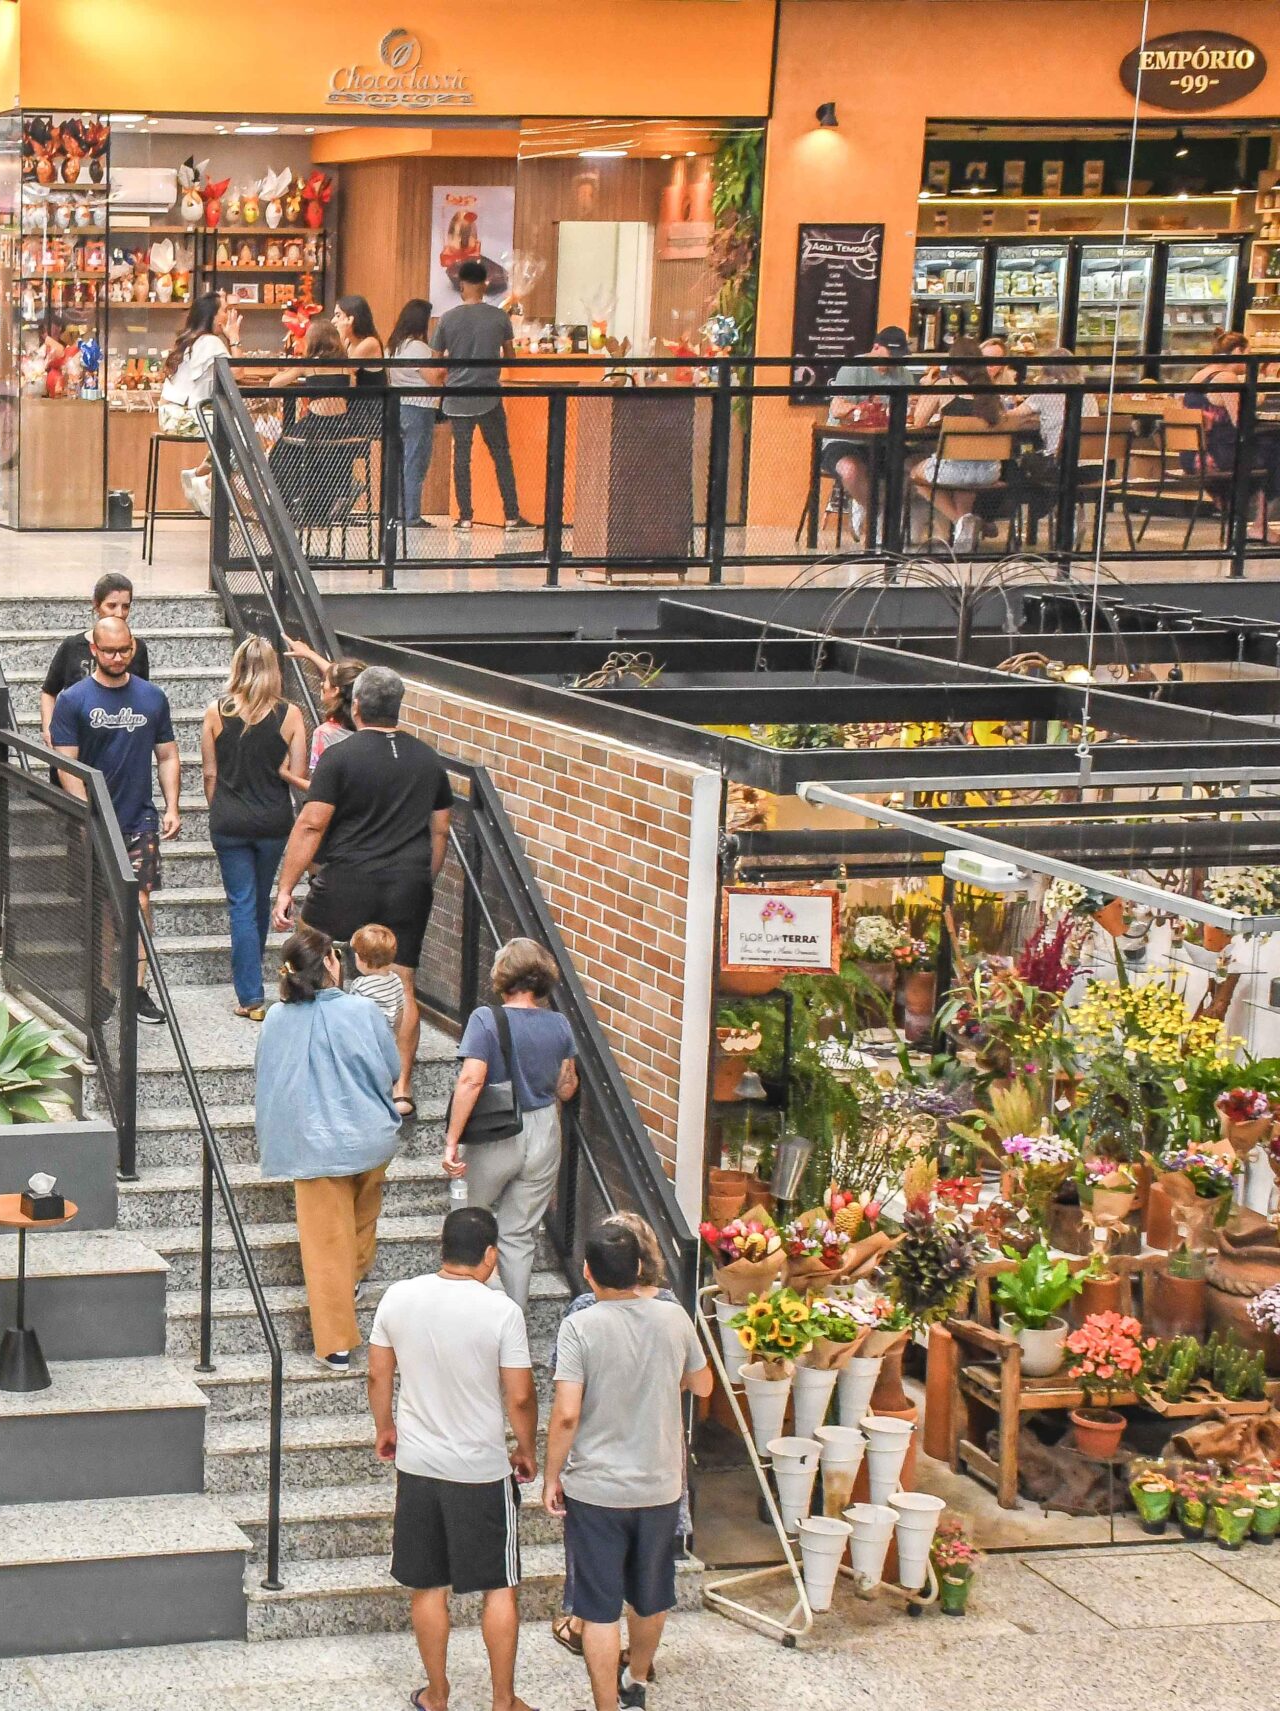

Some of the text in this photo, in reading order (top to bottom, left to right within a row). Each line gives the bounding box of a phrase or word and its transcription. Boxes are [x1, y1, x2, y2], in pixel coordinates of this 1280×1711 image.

[1138, 45, 1255, 70] EMPÓRIO
[329, 65, 470, 91] Chococlassic
[89, 707, 148, 732] Brooklyn
[739, 932, 817, 943] FLOR DA TERRA
